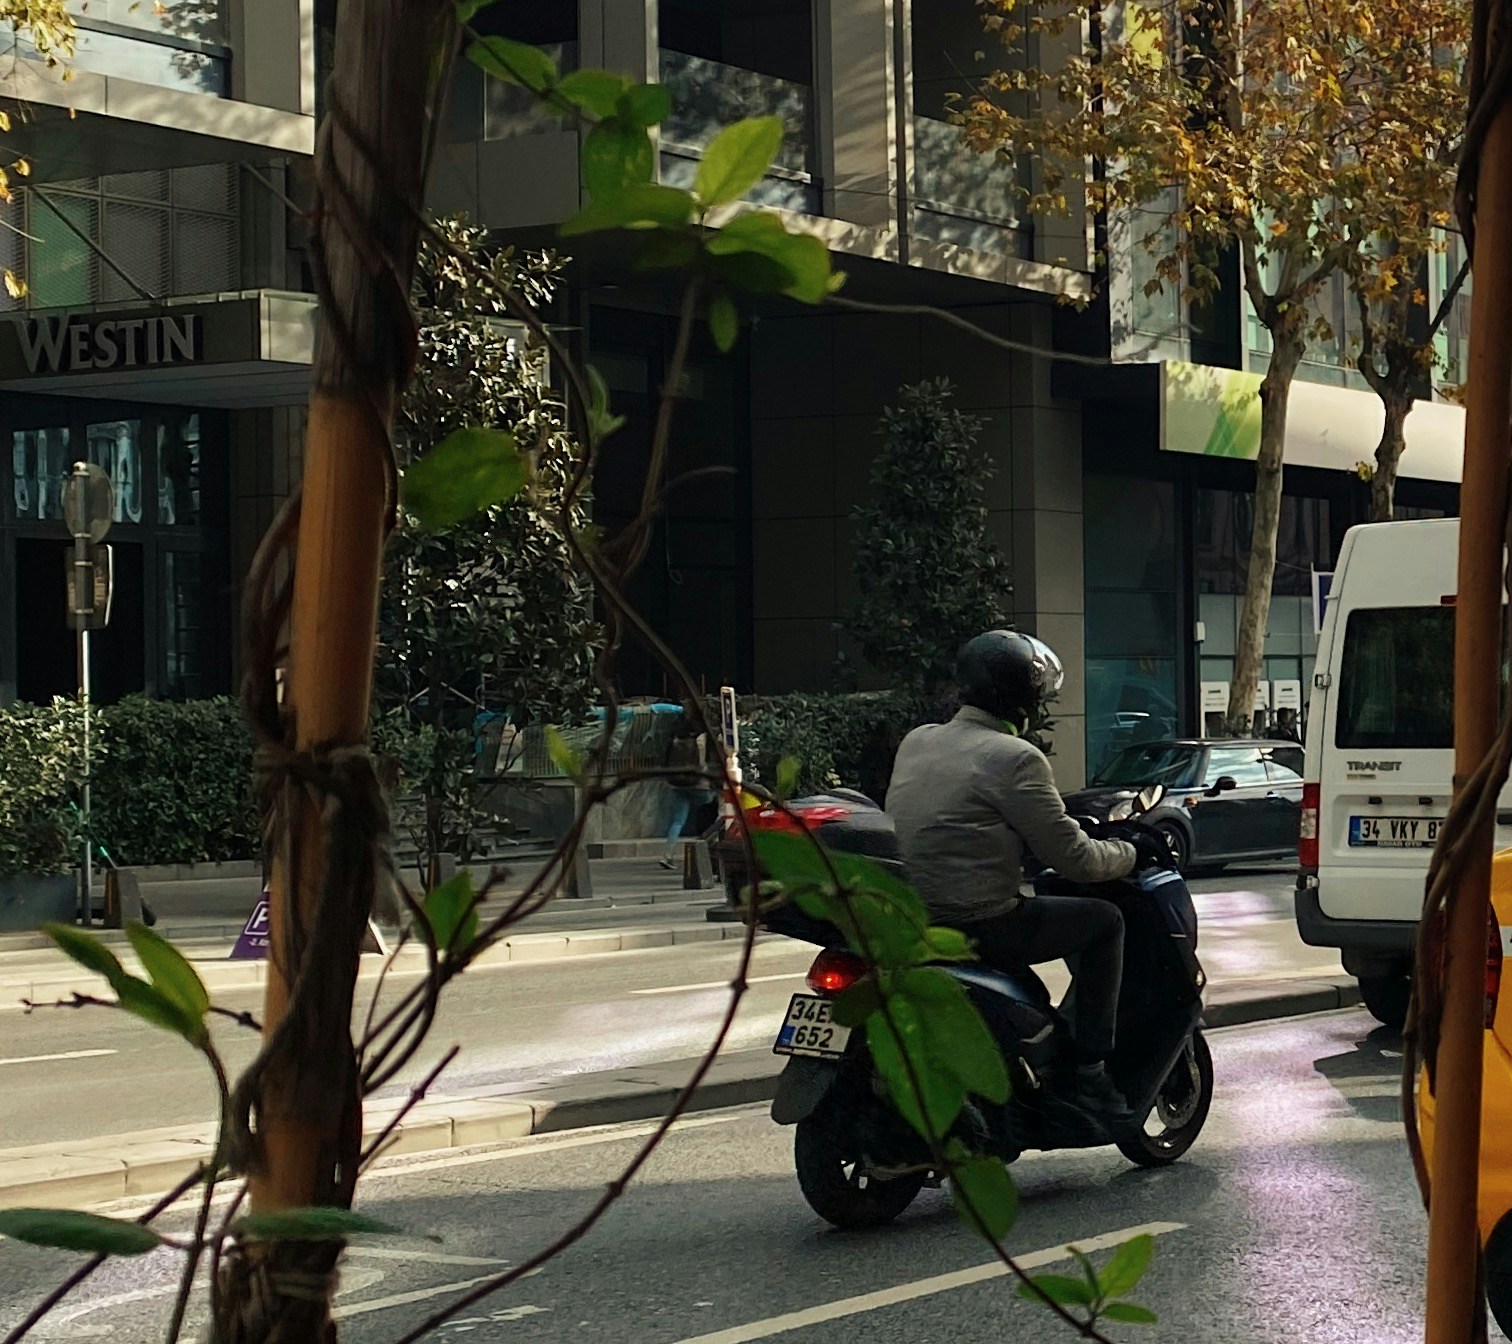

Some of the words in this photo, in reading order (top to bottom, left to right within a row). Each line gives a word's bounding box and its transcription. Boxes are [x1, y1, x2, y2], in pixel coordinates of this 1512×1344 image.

[13, 312, 196, 374] WESTIN
[1346, 761, 1402, 771] TRANSIT
[1361, 820, 1380, 839] 34
[1390, 820, 1418, 839] VKY
[1427, 821, 1443, 840] 8
[792, 1000, 833, 1023] 34E
[796, 1026, 833, 1048] 652
